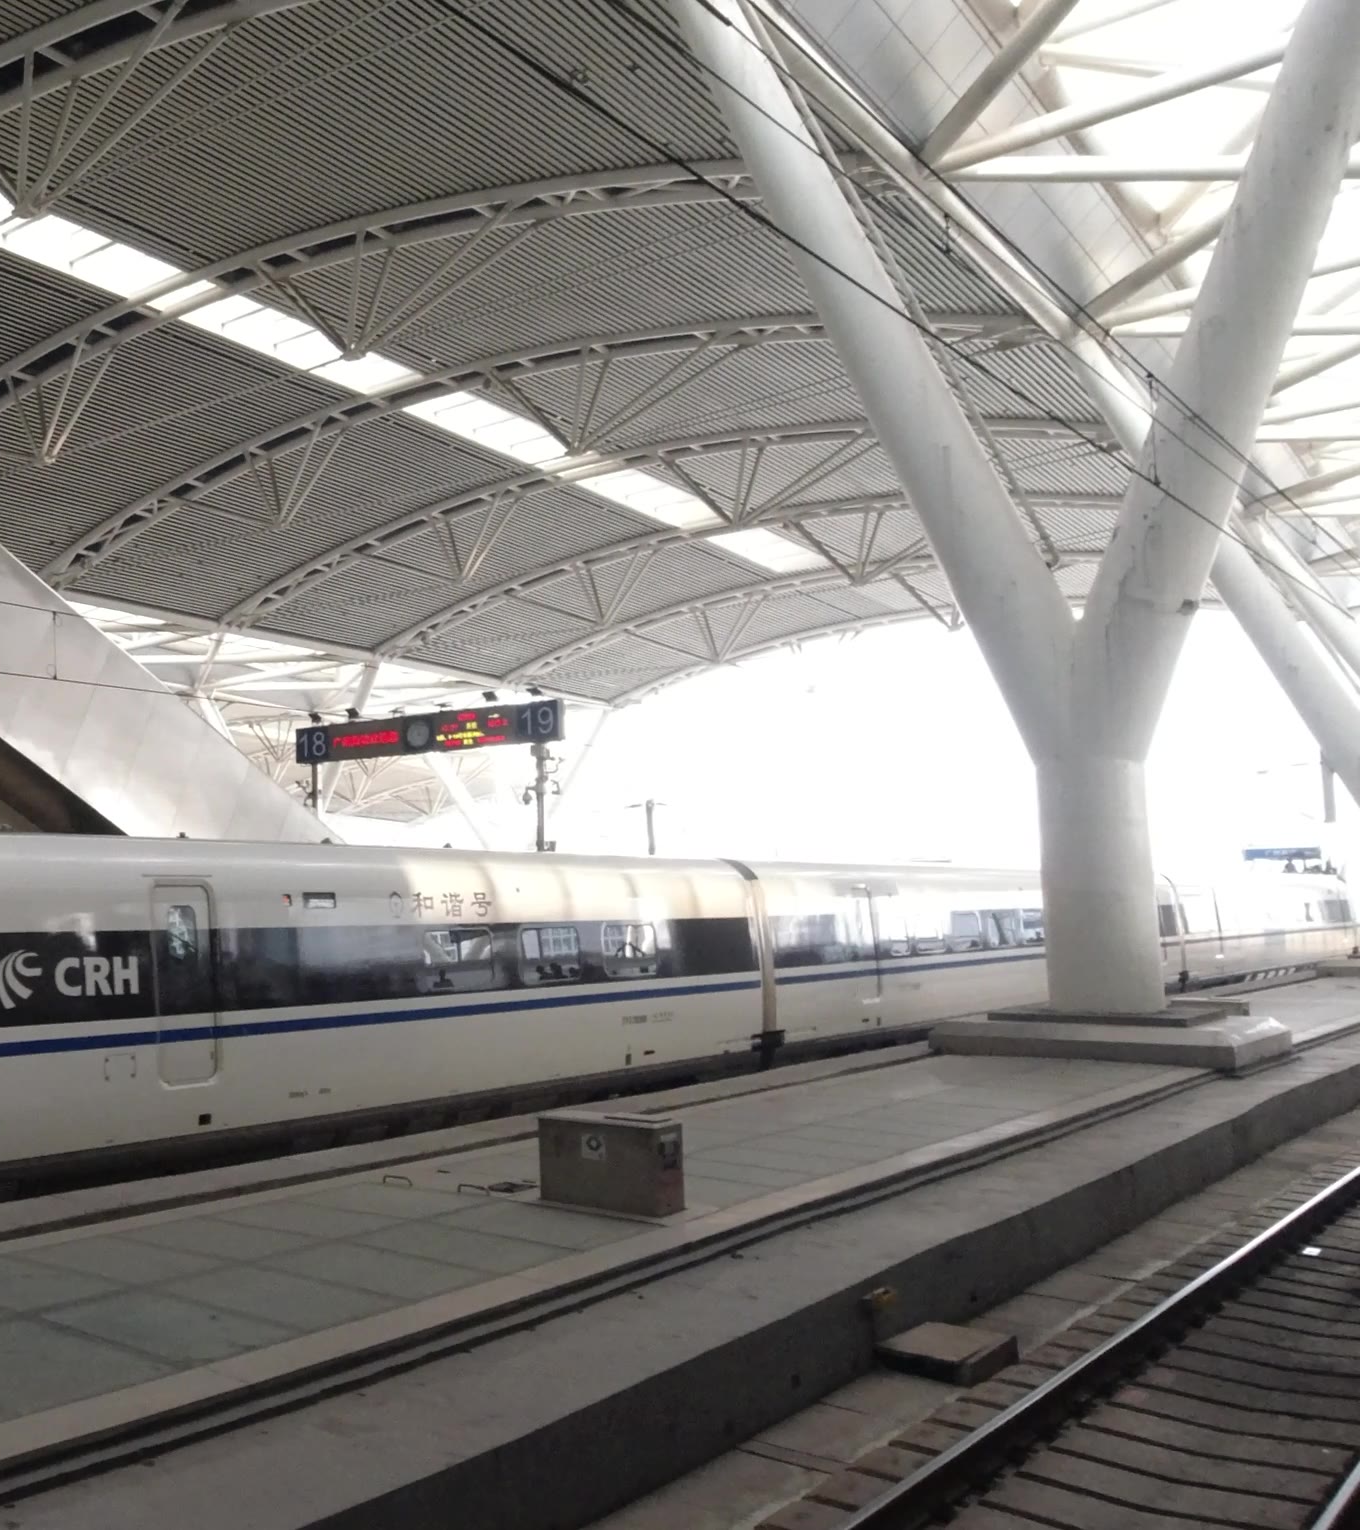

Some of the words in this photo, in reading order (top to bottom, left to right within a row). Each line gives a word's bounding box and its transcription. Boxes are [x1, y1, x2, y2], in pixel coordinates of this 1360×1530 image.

[521, 706, 553, 735] 19
[300, 731, 326, 757] 18
[411, 891, 493, 918] 和谐号
[54, 955, 140, 997] CRH
